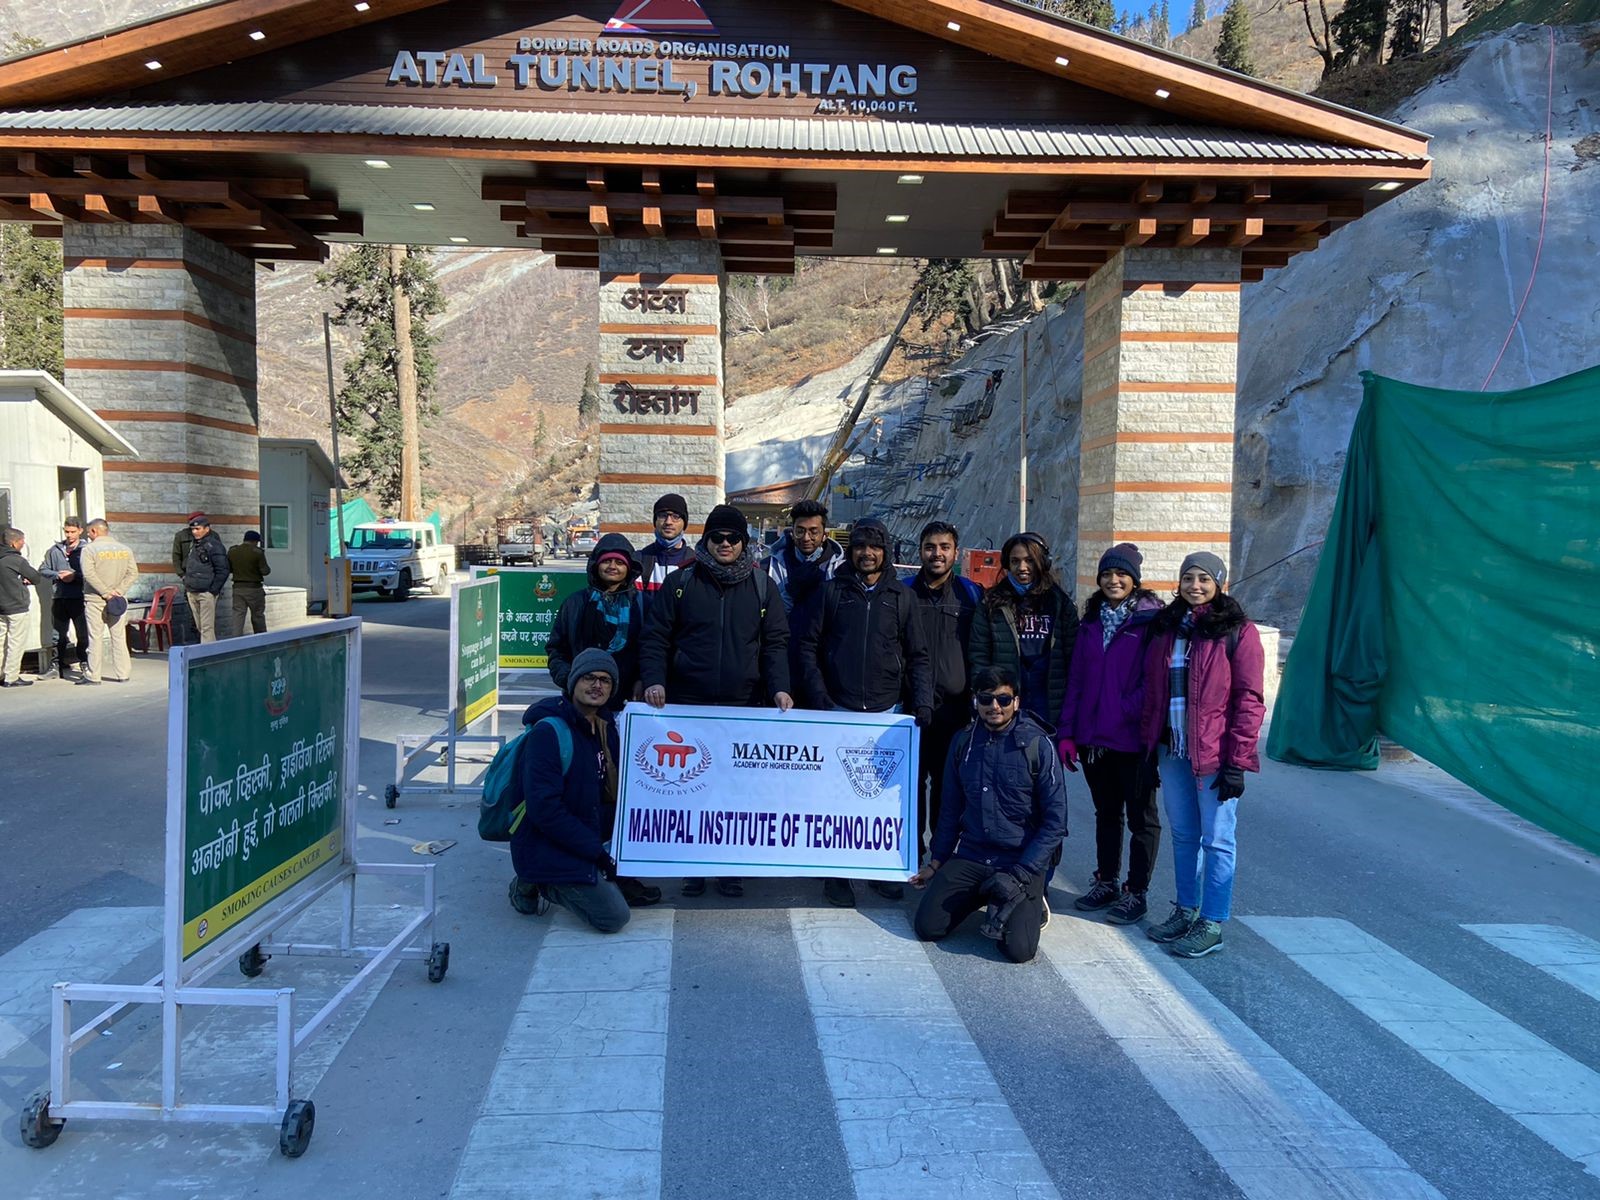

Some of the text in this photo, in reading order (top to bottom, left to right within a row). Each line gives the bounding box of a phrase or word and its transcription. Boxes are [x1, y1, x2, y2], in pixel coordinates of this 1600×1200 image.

[519, 37, 790, 58] BORDER ROADS ORGANISATION
[388, 50, 918, 98] ATAL TUNNEL, ROHTANG
[818, 98, 918, 113] ALT. 10,040 FT.
[621, 288, 689, 314] अटल
[622, 338, 688, 364] टनल
[609, 380, 702, 416] रोहतांग
[98, 551, 128, 560] POLICE
[519, 631, 530, 641] पर
[731, 742, 825, 763] MANIPAL
[733, 761, 760, 769] ACADEMY
[769, 762, 791, 770] HIGHER
[791, 763, 822, 771] EDUCATION
[199, 775, 233, 815] पीकर
[635, 779, 708, 796] INSPIRED BY LIFE
[191, 818, 240, 875] अनहोनी
[263, 802, 276, 839] तो
[279, 785, 306, 827] गलती
[628, 808, 904, 852] MANIPAL INSTITUTE OF TECHNOLOGY
[221, 848, 321, 921] SMOKING CAUSES CANCER
